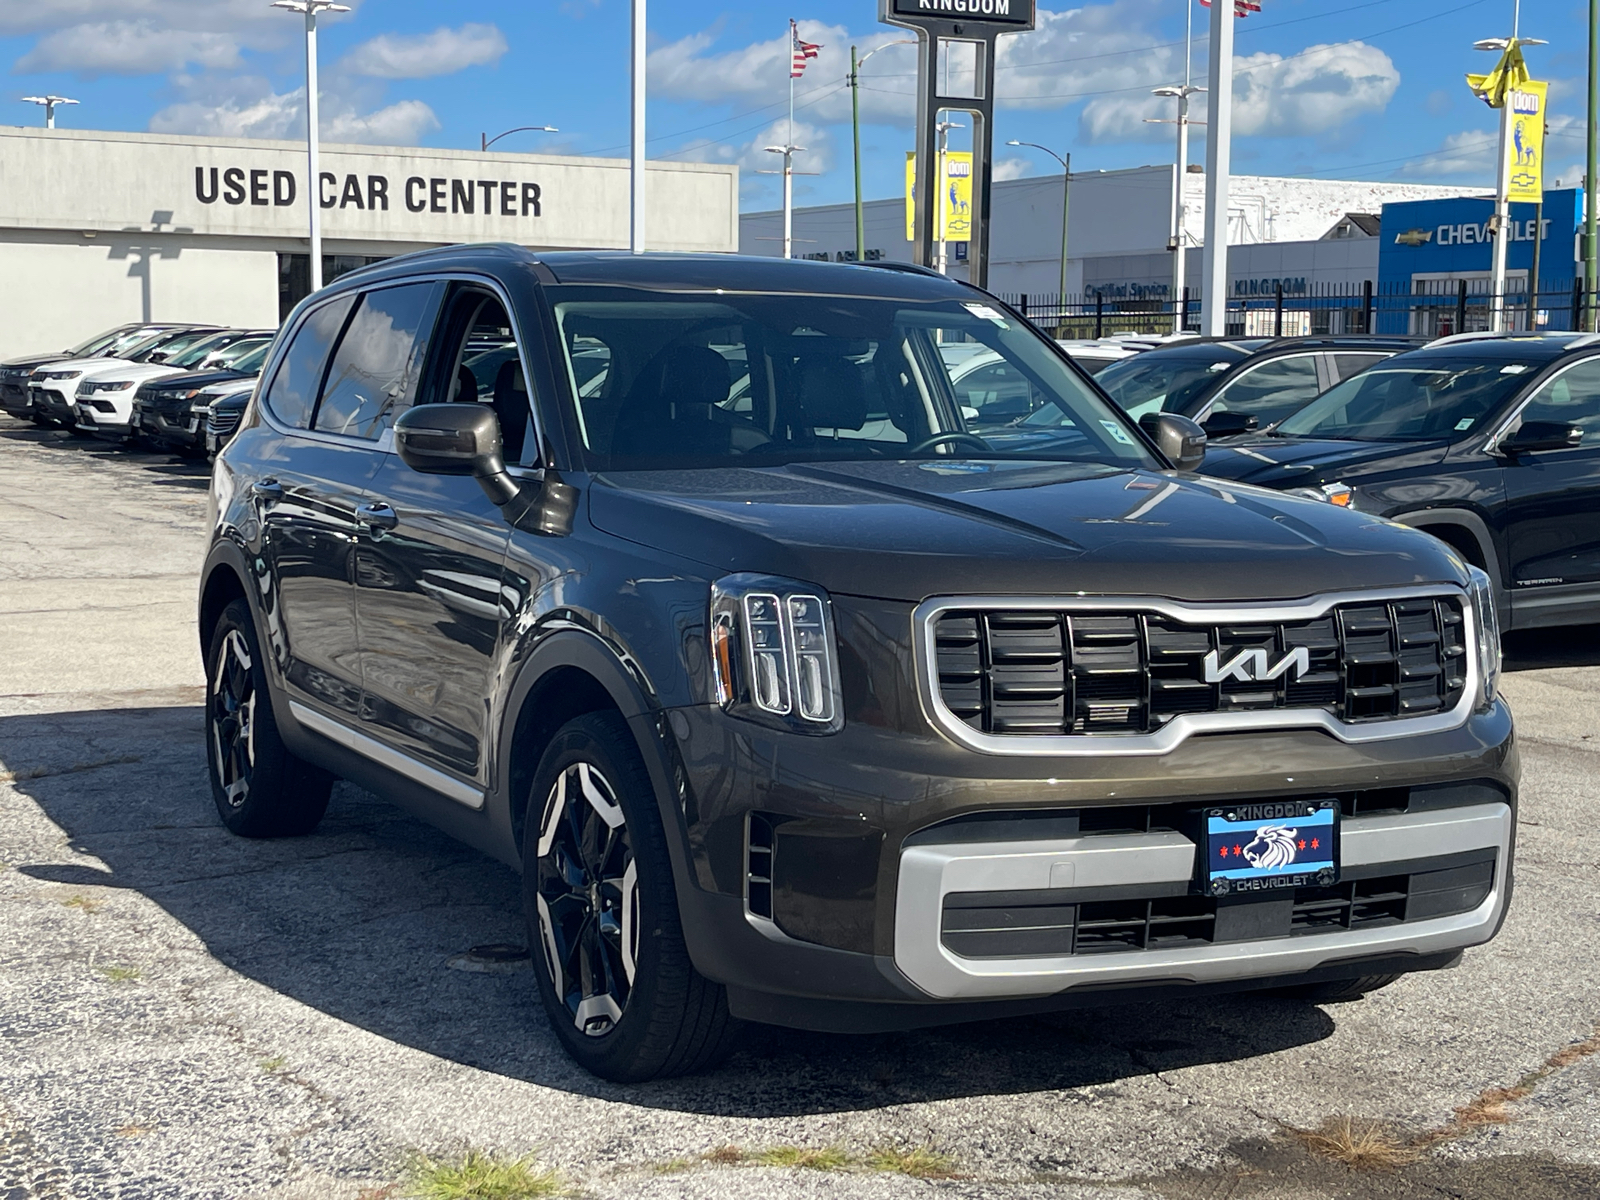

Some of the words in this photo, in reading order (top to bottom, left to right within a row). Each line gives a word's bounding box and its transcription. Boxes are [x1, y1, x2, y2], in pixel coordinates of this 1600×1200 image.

[919, 0, 1009, 15] KINGDOM
[195, 166, 296, 206] USED
[319, 172, 389, 211] CAR
[405, 176, 542, 217] CENTER
[1436, 219, 1552, 246] CHEVLET
[1085, 282, 1127, 298] Certified
[1130, 281, 1169, 297] Service
[1234, 277, 1306, 295] KINGDOM
[1516, 577, 1563, 586] TERRAIN
[1203, 646, 1310, 683] KIA
[1236, 802, 1309, 821] KINGDOM
[1236, 874, 1309, 892] CHEVROLET
